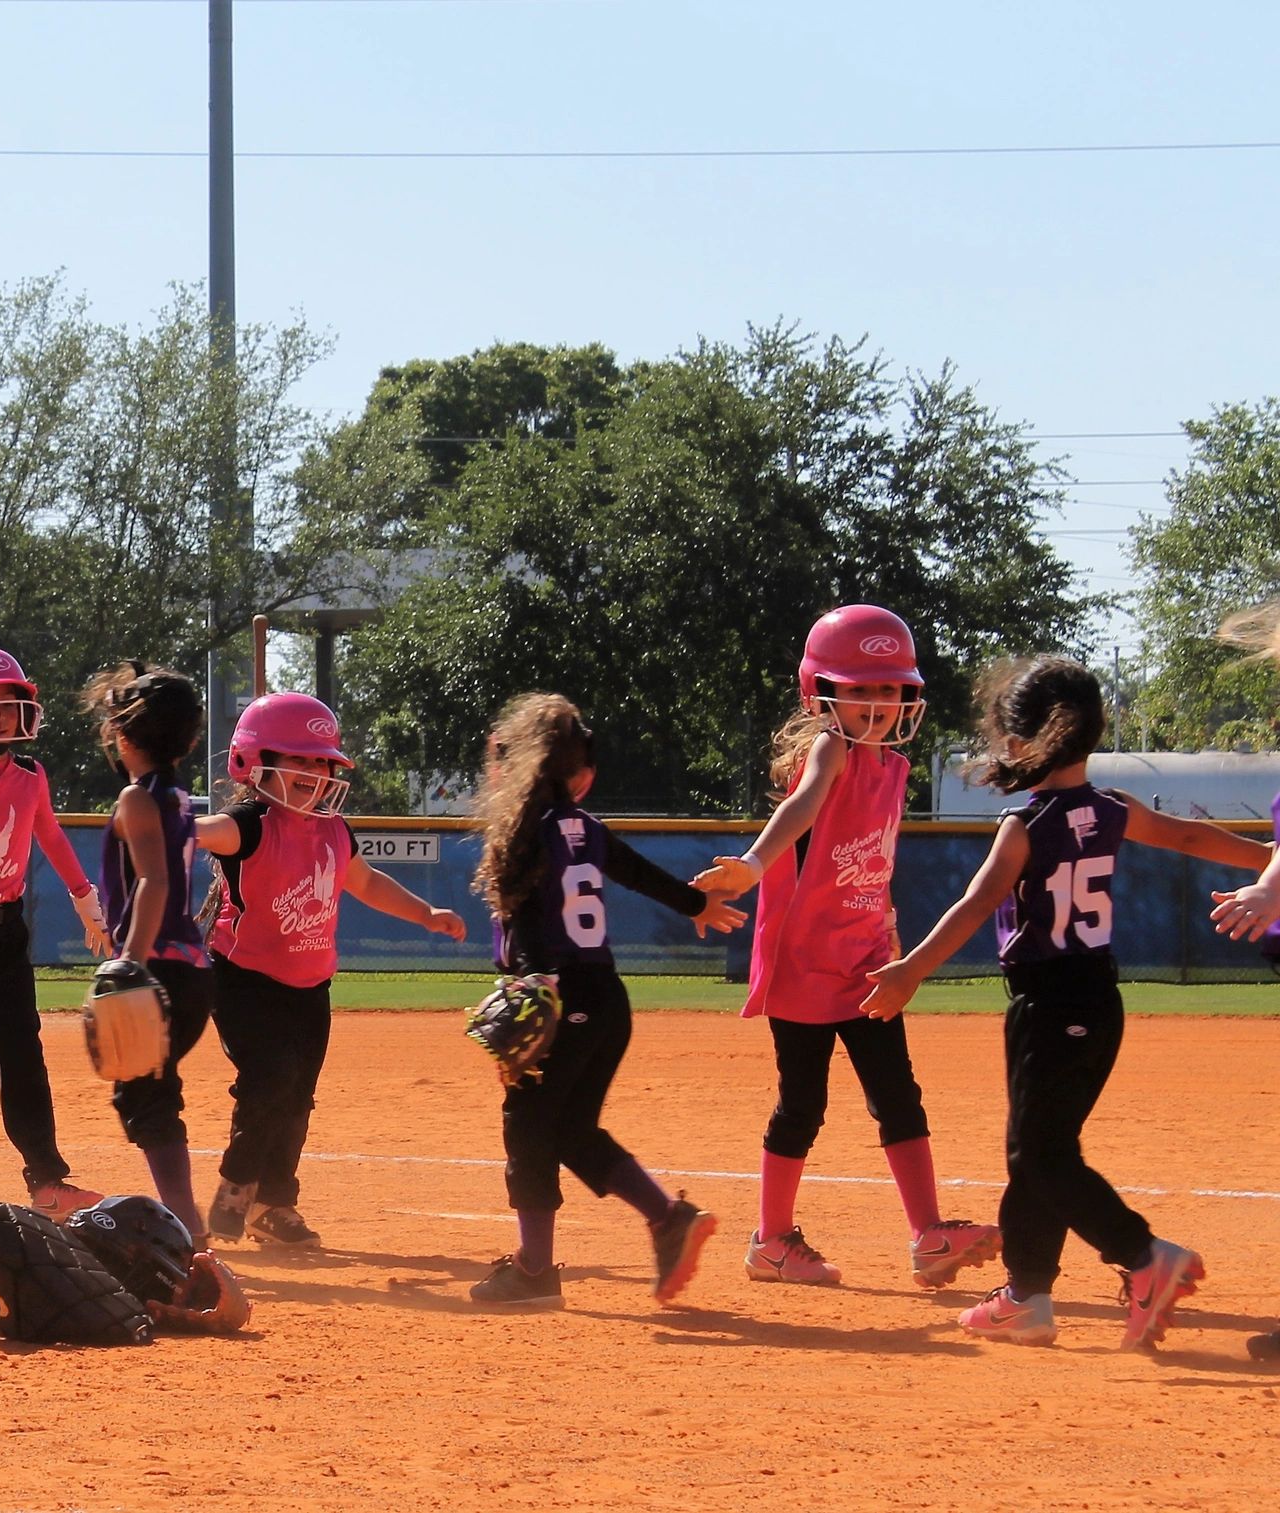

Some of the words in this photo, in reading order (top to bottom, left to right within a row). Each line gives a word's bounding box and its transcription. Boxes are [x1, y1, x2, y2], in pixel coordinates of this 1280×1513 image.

[362, 840, 396, 856] 210
[407, 841, 431, 856] FT
[831, 828, 883, 861] Celebrating
[837, 854, 854, 870] 35
[272, 875, 313, 913] Celebrating
[562, 863, 606, 948] 6
[1046, 855, 1115, 949] 15
[278, 903, 291, 920] 35
[300, 937, 329, 946] YOUTH
